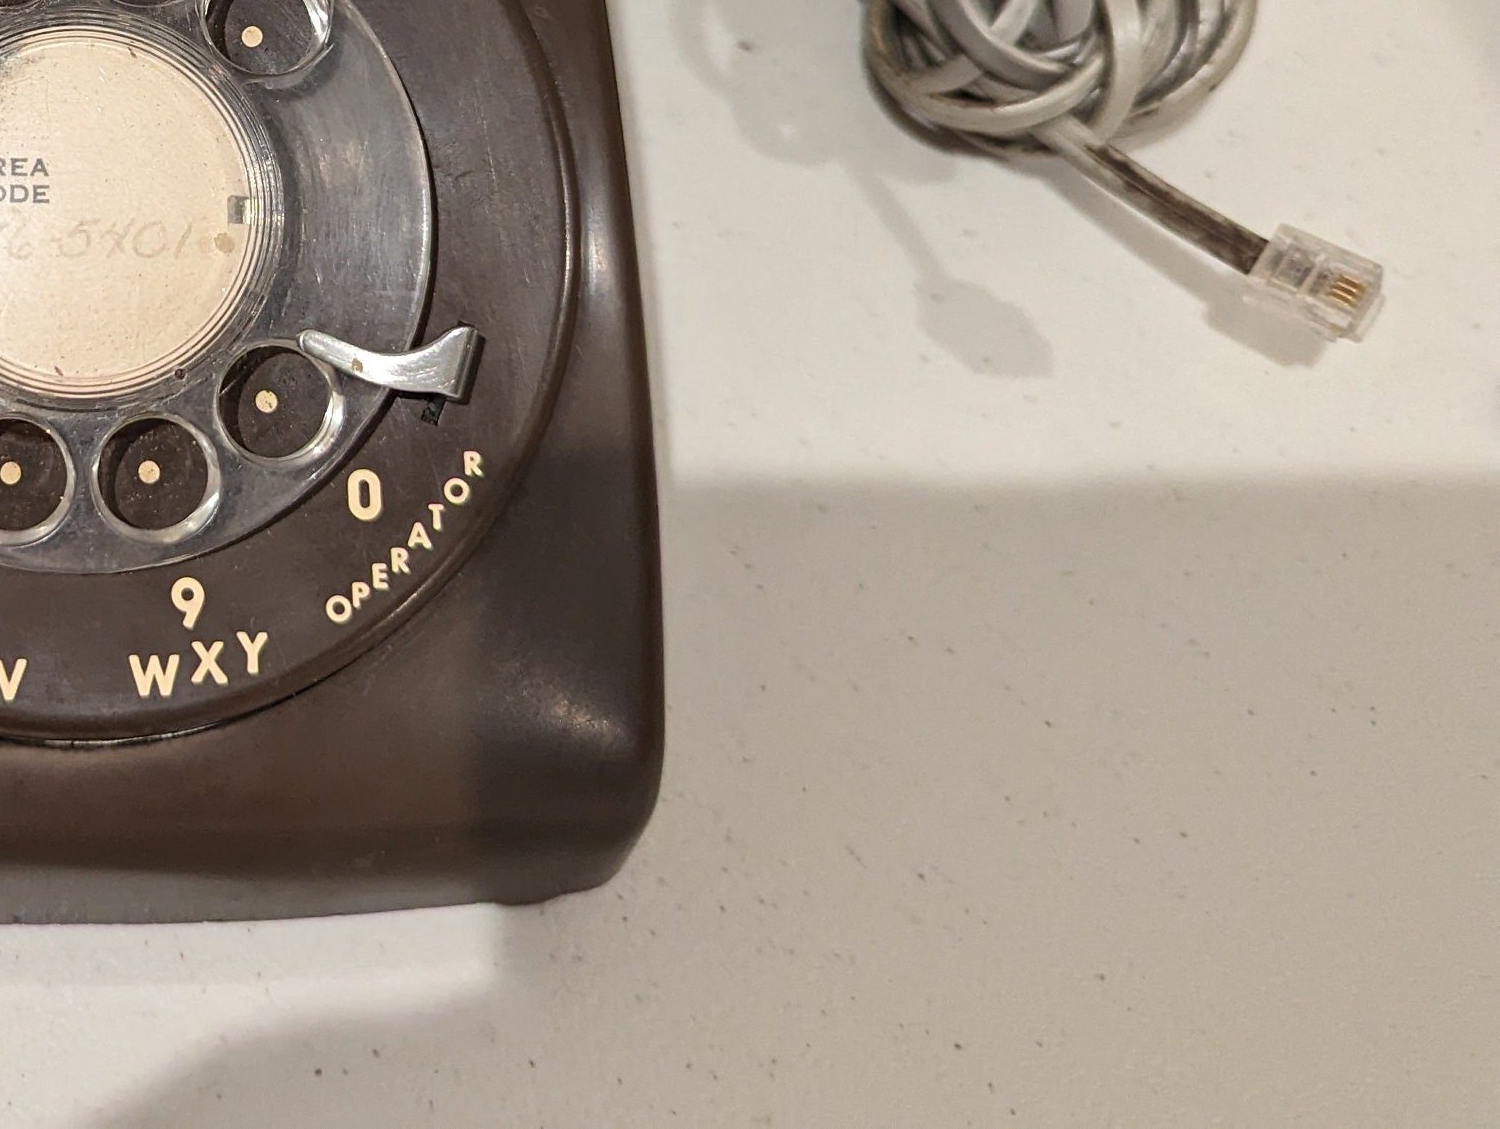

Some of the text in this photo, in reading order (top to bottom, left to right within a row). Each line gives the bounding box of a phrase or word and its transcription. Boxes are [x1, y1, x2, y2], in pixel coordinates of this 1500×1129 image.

[325, 450, 484, 625] OPERATOR
[170, 576, 205, 630] 9
[128, 631, 269, 698] WXY
